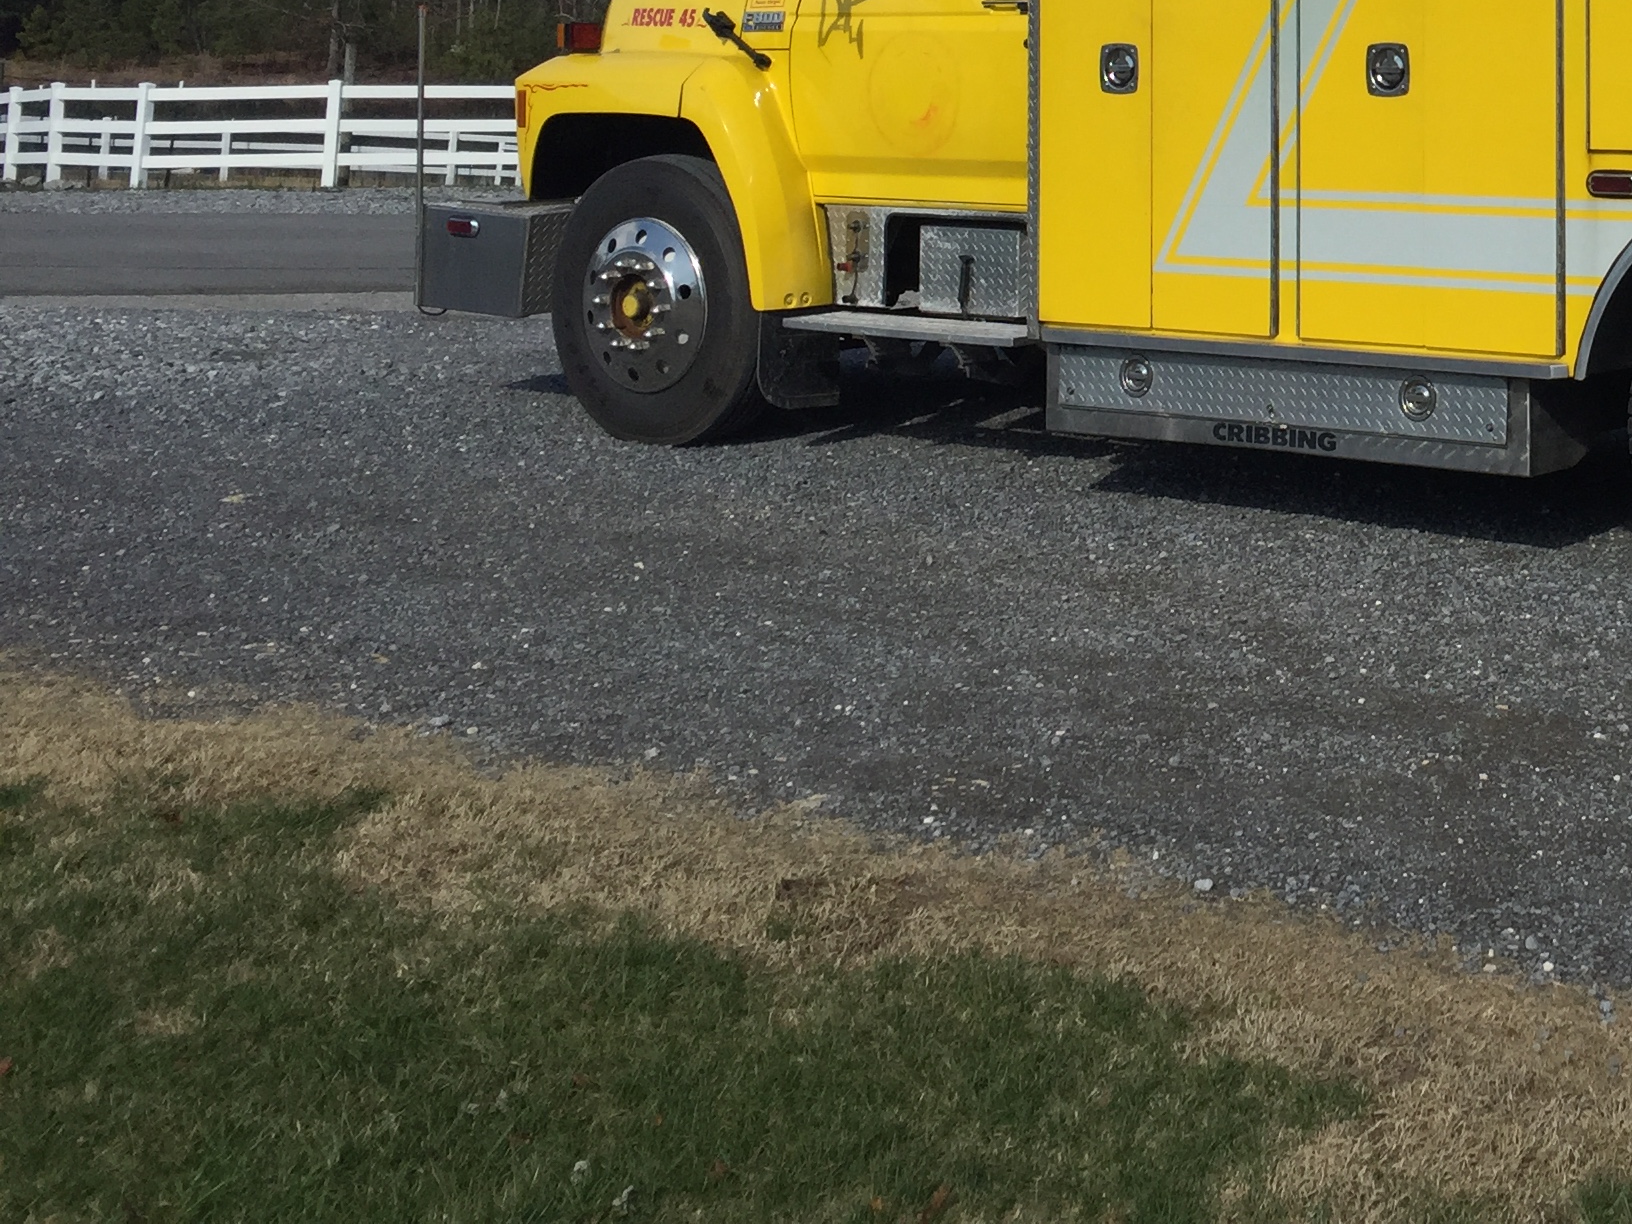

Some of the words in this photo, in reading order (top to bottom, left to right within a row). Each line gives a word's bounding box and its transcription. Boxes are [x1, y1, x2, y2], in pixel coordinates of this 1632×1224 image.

[631, 8, 675, 27] RESCUE
[679, 8, 697, 27] 45
[1212, 423, 1337, 452] CRIBBING
